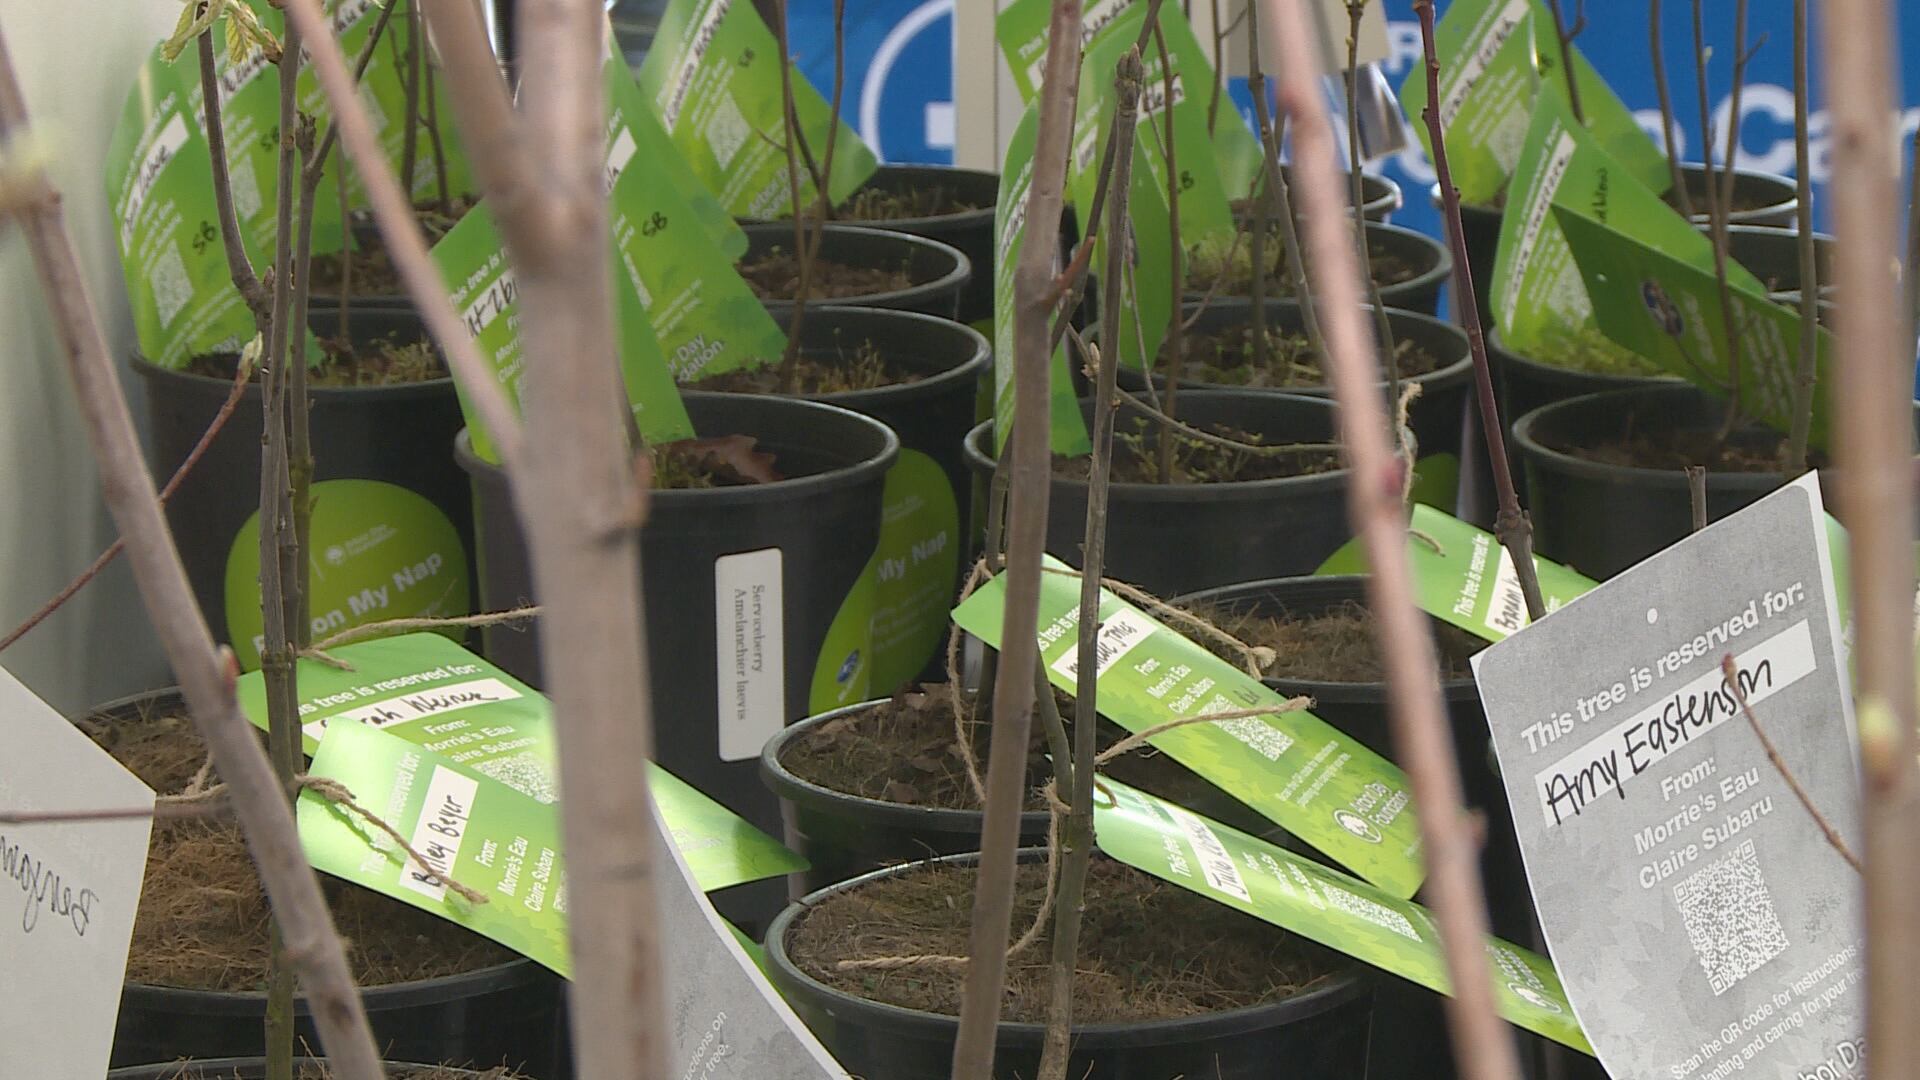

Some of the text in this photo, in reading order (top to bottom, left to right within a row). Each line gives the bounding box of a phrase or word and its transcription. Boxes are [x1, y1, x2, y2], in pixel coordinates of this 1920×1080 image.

[677, 339, 726, 384] dation
[348, 587, 390, 616] My
[392, 552, 443, 594] Nap
[734, 588, 749, 677] Amelanchier
[752, 584, 765, 673] Serviceberry
[319, 690, 357, 709] tree
[355, 685, 376, 698] is
[374, 666, 449, 692] reserved
[1521, 581, 1805, 755] This tree is reserved for:
[450, 748, 482, 763] aire
[481, 724, 516, 738] Eau
[1545, 749, 1626, 826] Amy
[1633, 766, 1761, 855] Morrie's Eau
[1660, 757, 1718, 801] From:
[496, 835, 529, 897] Morrie's Eau
[1638, 795, 1775, 890] Claire Subaru
[523, 847, 555, 913] Claire Subaru
[711, 1010, 729, 1033] on
[1670, 1052, 1703, 1080] Scan
[1700, 1041, 1723, 1060] the
[1721, 1022, 1744, 1046] QR
[1742, 1002, 1774, 1032] code
[1772, 990, 1793, 1009] for
[1791, 944, 1858, 997] instructions
[1700, 1053, 1745, 1080] lanting
[1741, 1036, 1767, 1060] and
[1764, 1011, 1805, 1044] caring
[1803, 998, 1824, 1017] for
[1820, 982, 1851, 1008] your
[705, 1043, 730, 1072] tree.
